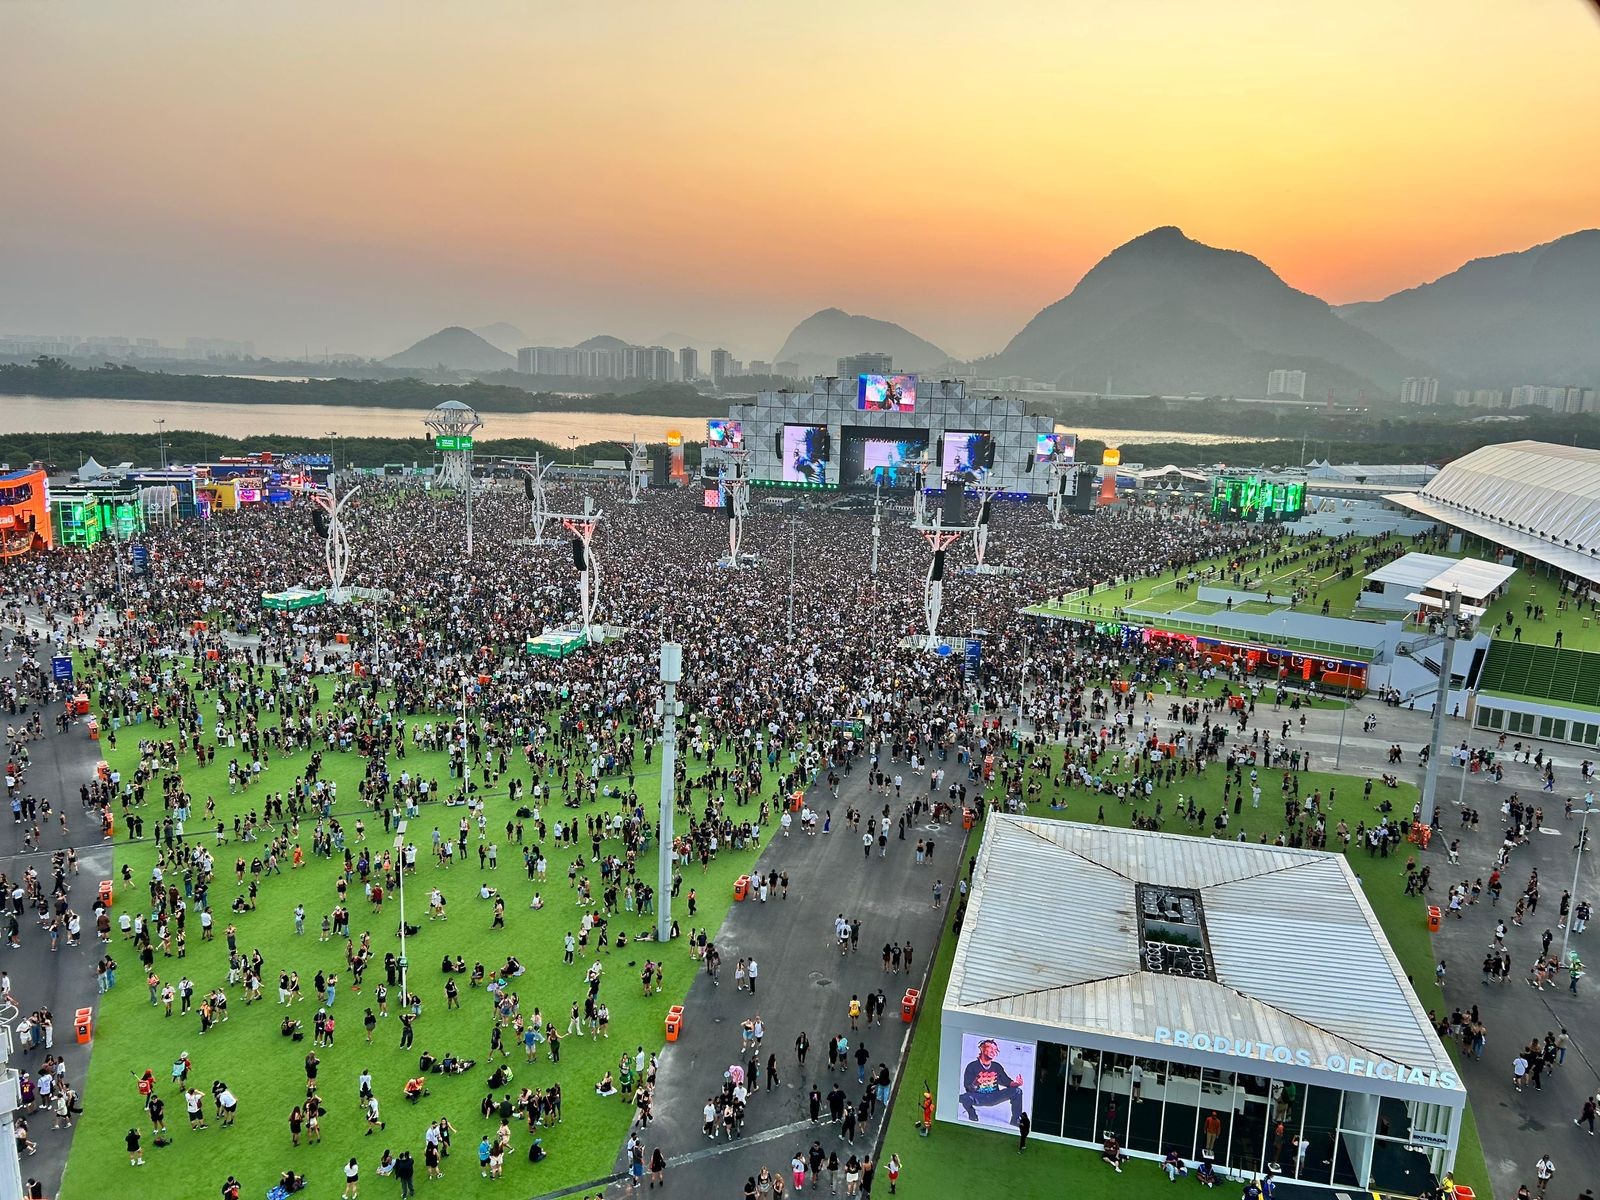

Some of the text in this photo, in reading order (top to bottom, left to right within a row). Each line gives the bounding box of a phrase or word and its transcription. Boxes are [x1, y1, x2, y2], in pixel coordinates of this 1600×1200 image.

[1154, 1026, 1457, 1089] PRODUTOS OFICIAIS
[1413, 1134, 1448, 1144] ENTRADA
